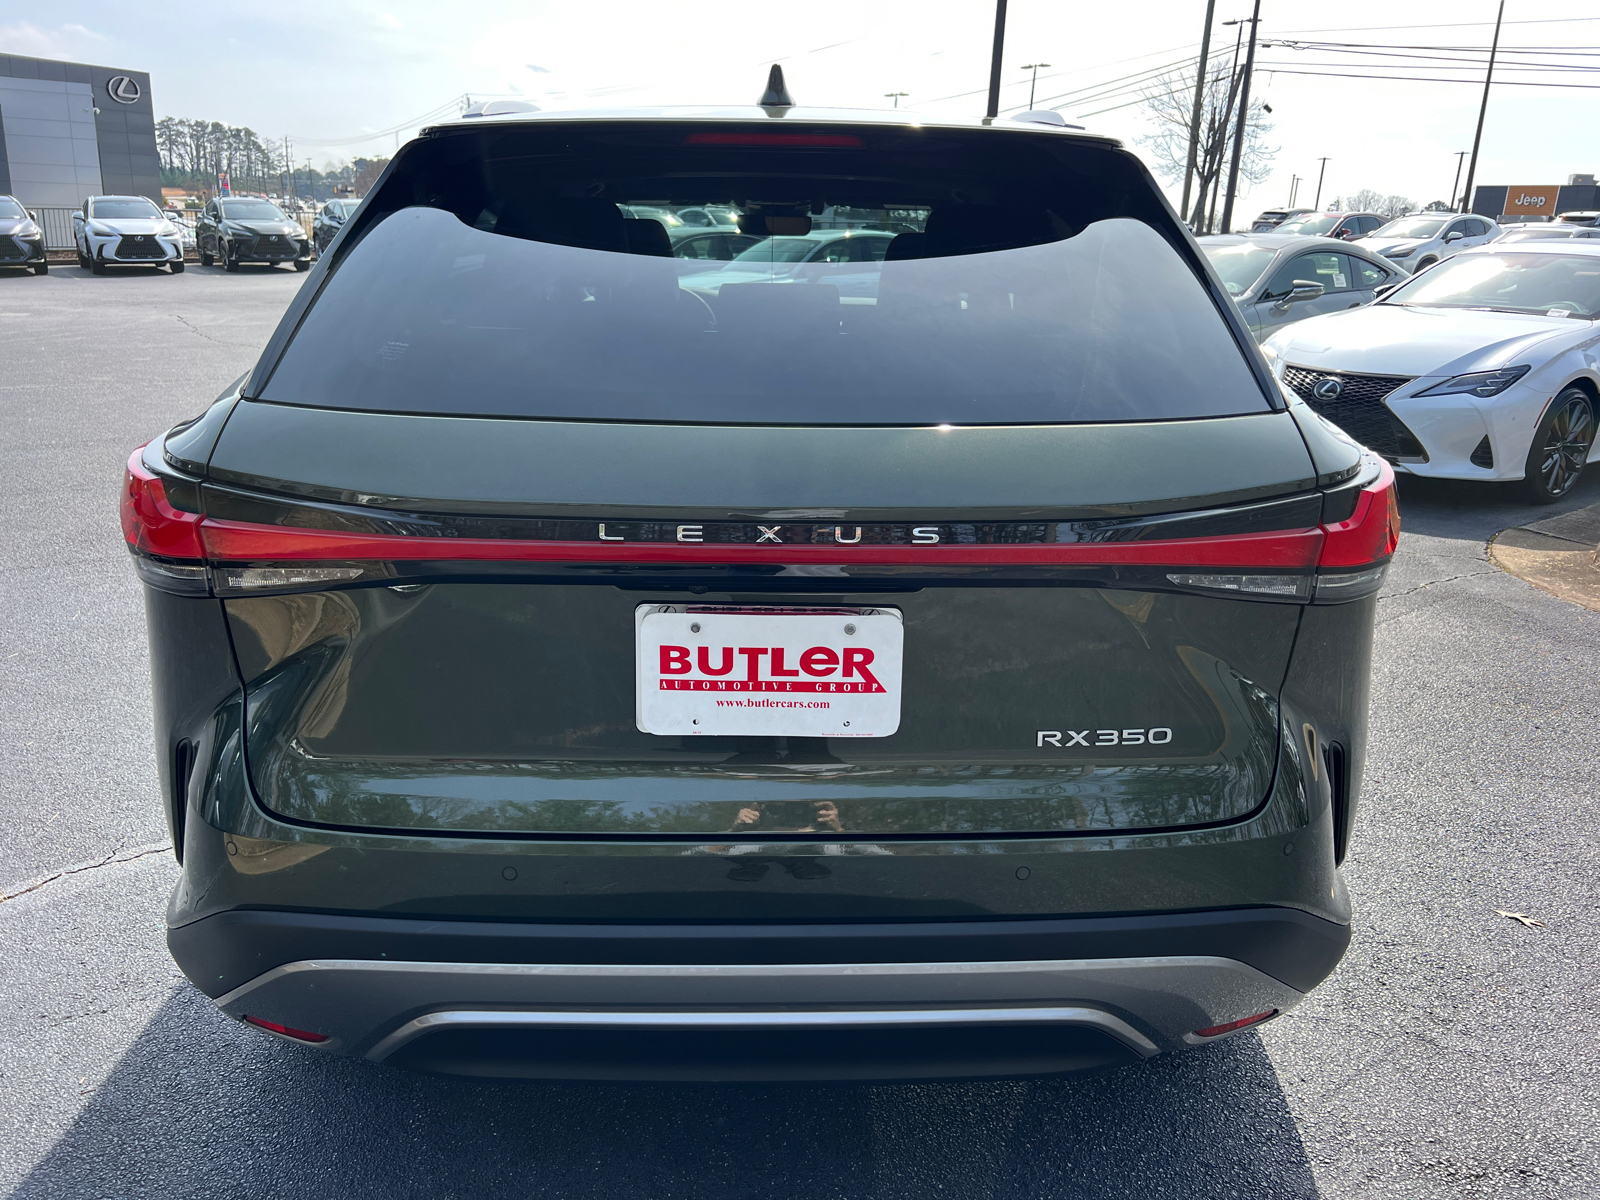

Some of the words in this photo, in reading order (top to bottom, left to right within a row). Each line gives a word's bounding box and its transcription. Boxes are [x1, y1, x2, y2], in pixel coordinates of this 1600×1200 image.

[1515, 193, 1546, 208] Jeep
[598, 523, 940, 544] LEXUS
[660, 681, 793, 691] AUTOMOTIVE
[815, 683, 879, 692] GROUP
[716, 698, 831, 709] www.butlercars.com
